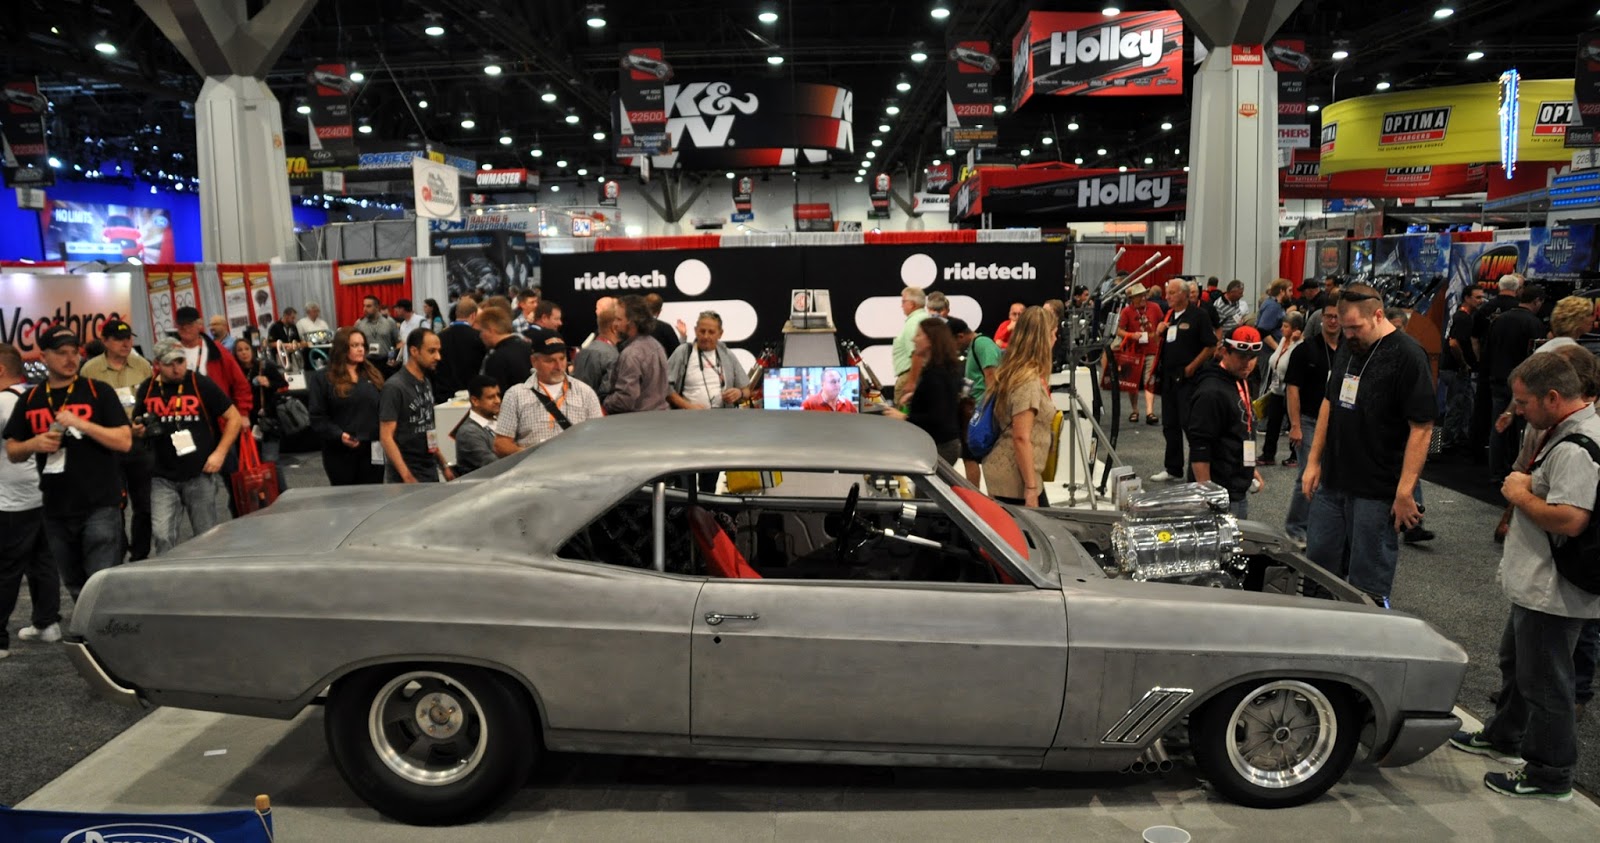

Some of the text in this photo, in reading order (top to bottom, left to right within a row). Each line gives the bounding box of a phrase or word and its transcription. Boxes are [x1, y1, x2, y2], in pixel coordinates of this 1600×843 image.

[1050, 26, 1164, 67] Holley
[958, 105, 990, 115] 22600
[1278, 104, 1302, 113] 2700
[1582, 104, 1600, 114] 228
[1384, 111, 1446, 133] OPTIMA
[320, 127, 349, 137] 22400
[1278, 129, 1310, 138] THERS
[1393, 132, 1431, 142] CHARGERS
[476, 172, 521, 185] OWMASTER
[1078, 174, 1171, 209] Holley
[469, 221, 528, 231] PERFORMANCE
[944, 262, 1037, 280] ridetech
[574, 269, 667, 290] ridetech
[0, 301, 121, 352] Veethre
[144, 395, 201, 417] TMR
